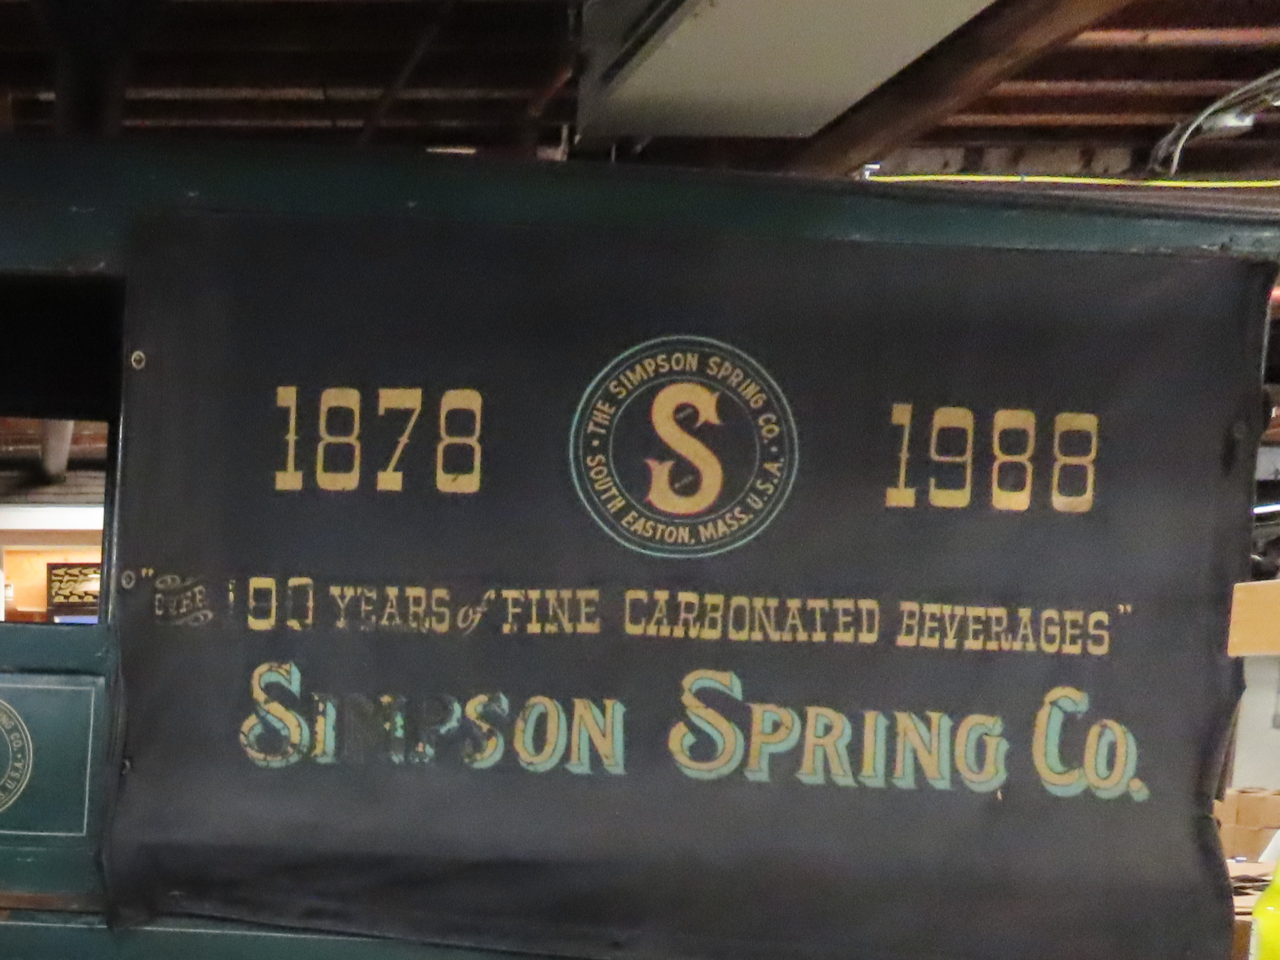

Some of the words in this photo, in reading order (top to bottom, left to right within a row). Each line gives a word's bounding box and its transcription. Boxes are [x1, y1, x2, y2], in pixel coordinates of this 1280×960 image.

[275, 386, 483, 494] 1878
[587, 400, 617, 436] THE
[609, 352, 700, 399] SIMPSON
[706, 356, 768, 410] SPRING
[586, 454, 626, 514] SOUTH
[621, 511, 696, 545] EASTON,
[698, 507, 754, 543] MASS.
[643, 381, 724, 517] S
[885, 403, 1099, 513] 1988
[329, 586, 451, 634] YEARS
[457, 589, 496, 636] of
[500, 589, 600, 634] FINE
[624, 589, 880, 643] CARBONATED
[668, 668, 1010, 793] SPRING
